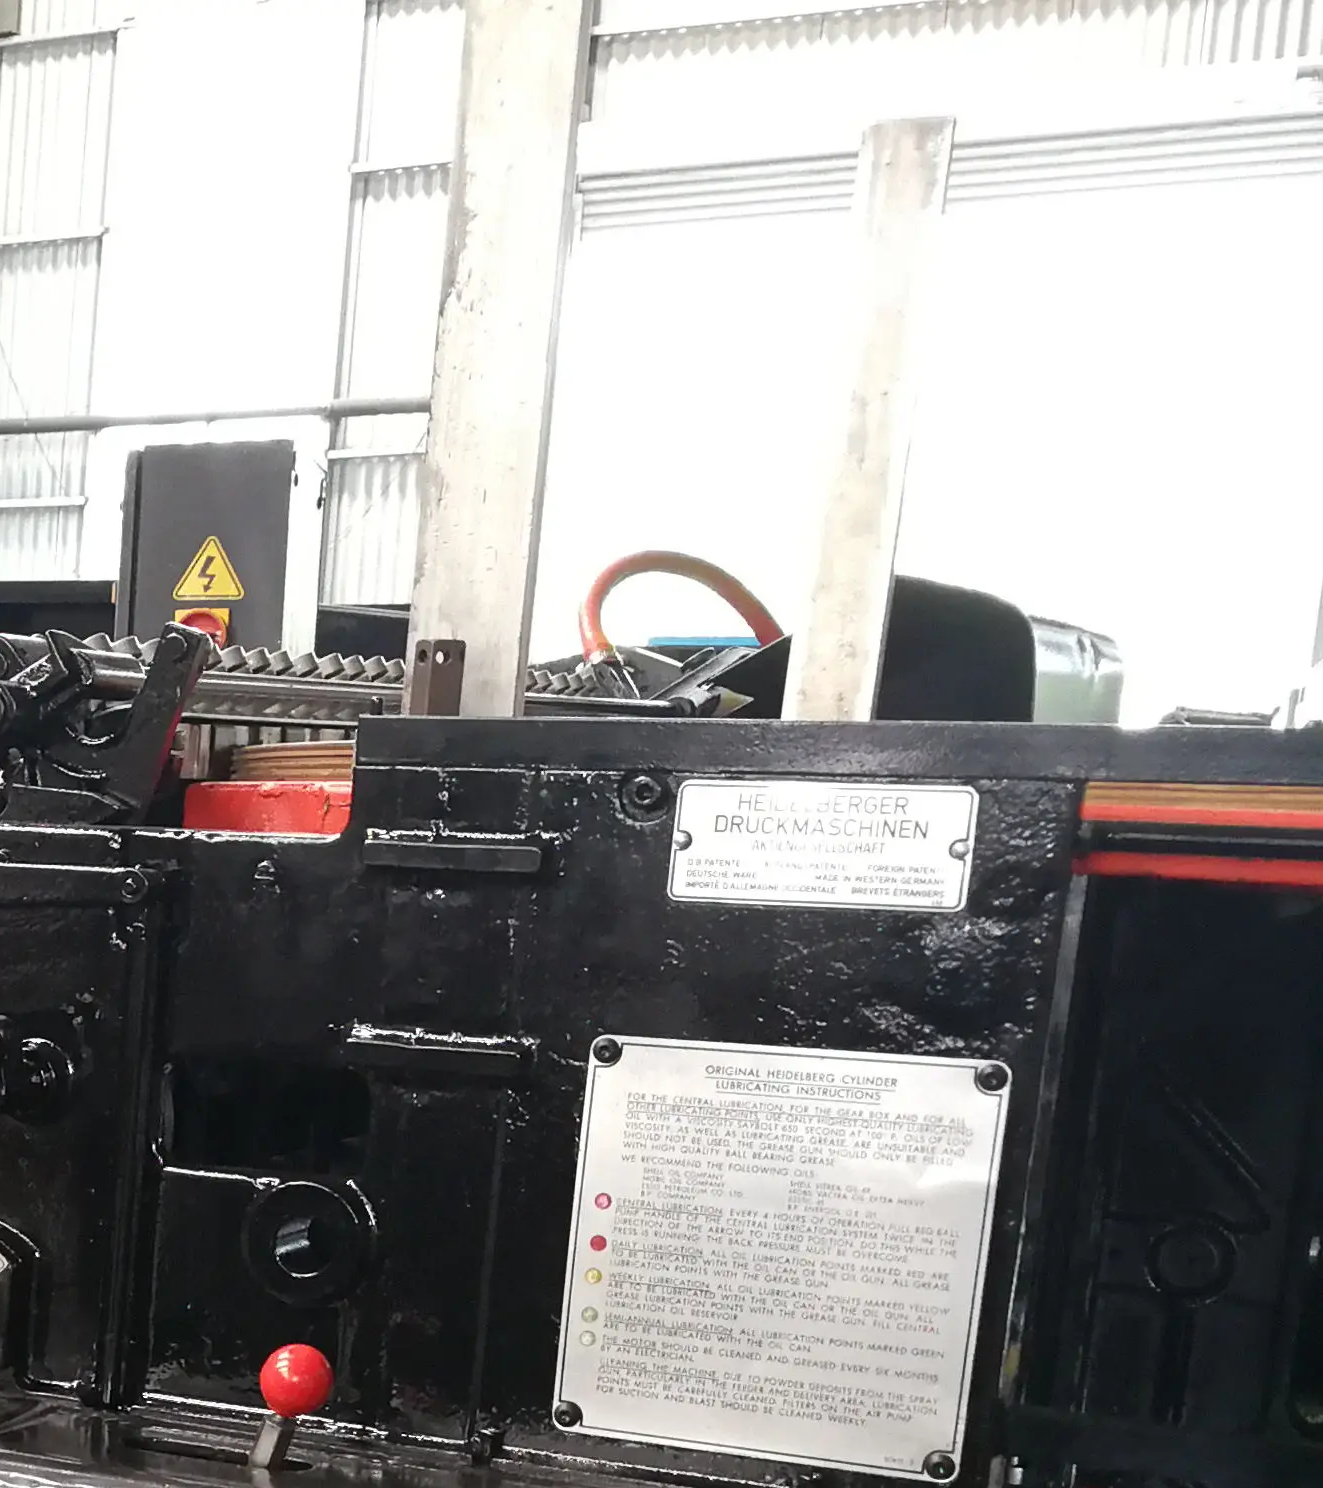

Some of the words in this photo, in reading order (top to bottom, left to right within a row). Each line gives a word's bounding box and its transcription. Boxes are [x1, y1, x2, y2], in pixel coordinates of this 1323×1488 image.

[714, 815, 929, 839] DRUCKMASCHINEN
[687, 869, 730, 878] DEUTSCHE
[867, 864, 906, 873] FOREIGN
[855, 877, 898, 885] WESTERN
[901, 877, 945, 885] GERMANY
[704, 1065, 760, 1077] ORIGINAL
[766, 1069, 835, 1082] HEIDELBERG
[841, 1074, 897, 1087] CYLINDER
[715, 1080, 790, 1093] LUBRICATING
[796, 1086, 881, 1100] INSTRUCTIONS
[620, 1154, 635, 1162] WE
[640, 1156, 701, 1168] RECOMMEND
[706, 1161, 723, 1170] THE
[727, 1163, 789, 1176] FOLLOWING
